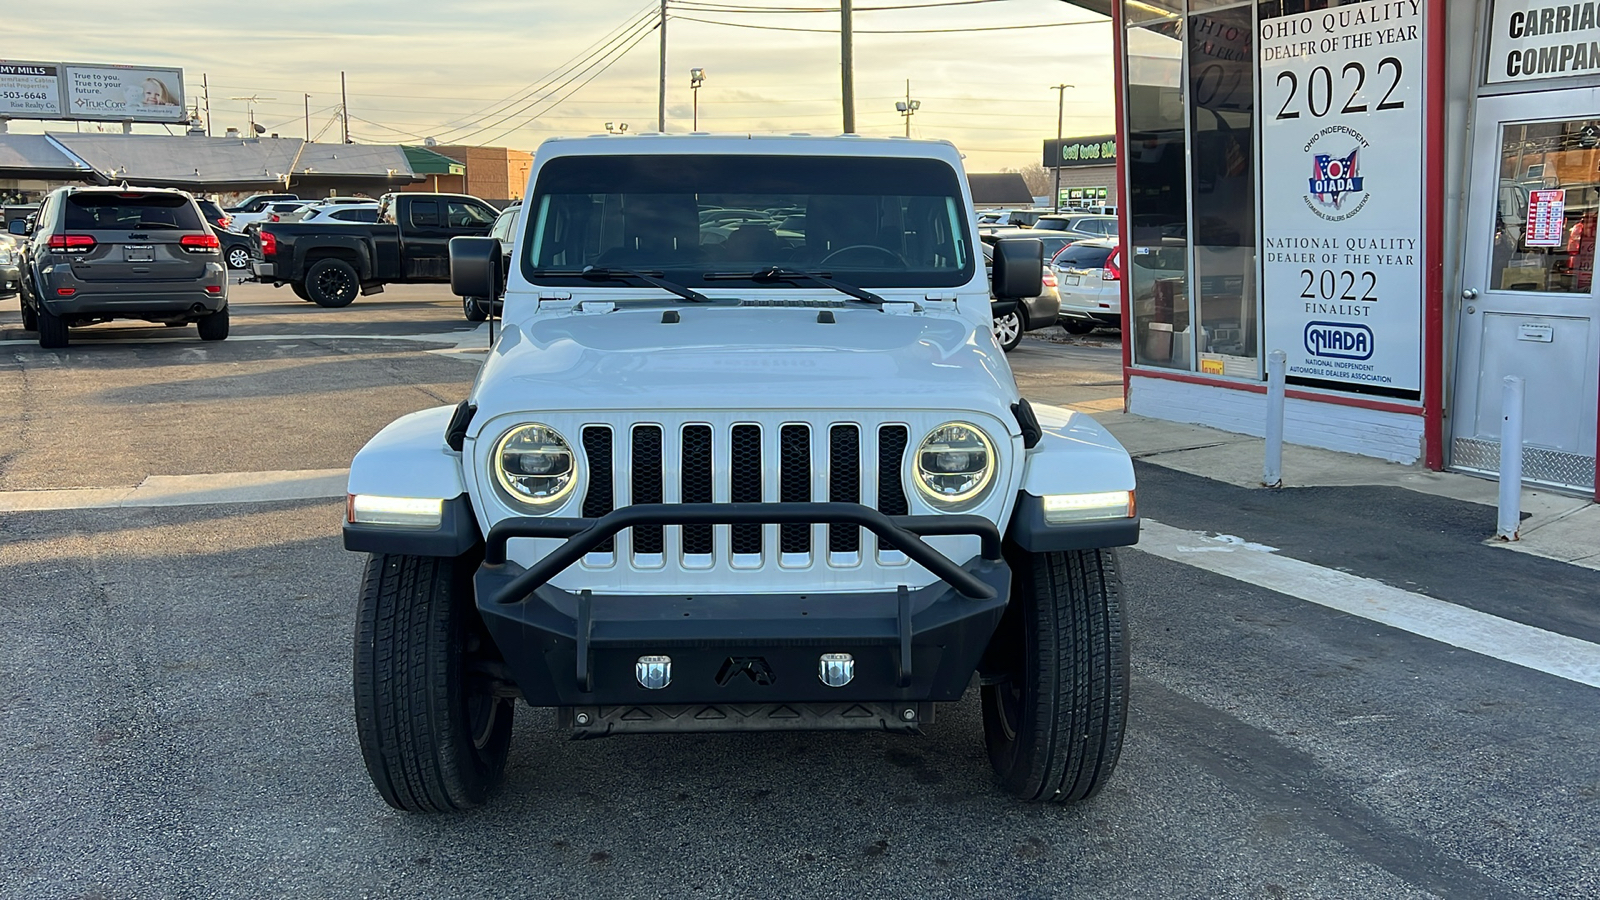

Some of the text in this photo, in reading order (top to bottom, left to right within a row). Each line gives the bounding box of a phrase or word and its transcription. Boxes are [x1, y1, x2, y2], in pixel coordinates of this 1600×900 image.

[1262, 0, 1420, 40] OHIO QUALITY
[1509, 1, 1600, 38] CARRIA
[1264, 25, 1418, 61] DEALER OF THE YEAR
[18, 67, 46, 75] MILLS
[74, 72, 91, 80] True
[1275, 56, 1405, 120] 2022
[25, 101, 45, 110] Realty
[1303, 125, 1370, 153] OHIO INDEPENDENT
[1315, 178, 1354, 192] OIADA
[1302, 192, 1371, 222] AUTOMOBILE DEALERS ASSOCIATION
[1266, 237, 1416, 251] NATIONAL QUALITY
[1268, 252, 1414, 266] DEALER OF THE YEAR
[1300, 269, 1378, 302] 2022
[1305, 302, 1371, 317] FINALIST
[1305, 358, 1374, 372] NATIONAL INDEPENDENT
[1289, 366, 1392, 383] AUTOMOBILE DEALERS ASSOCIATION
